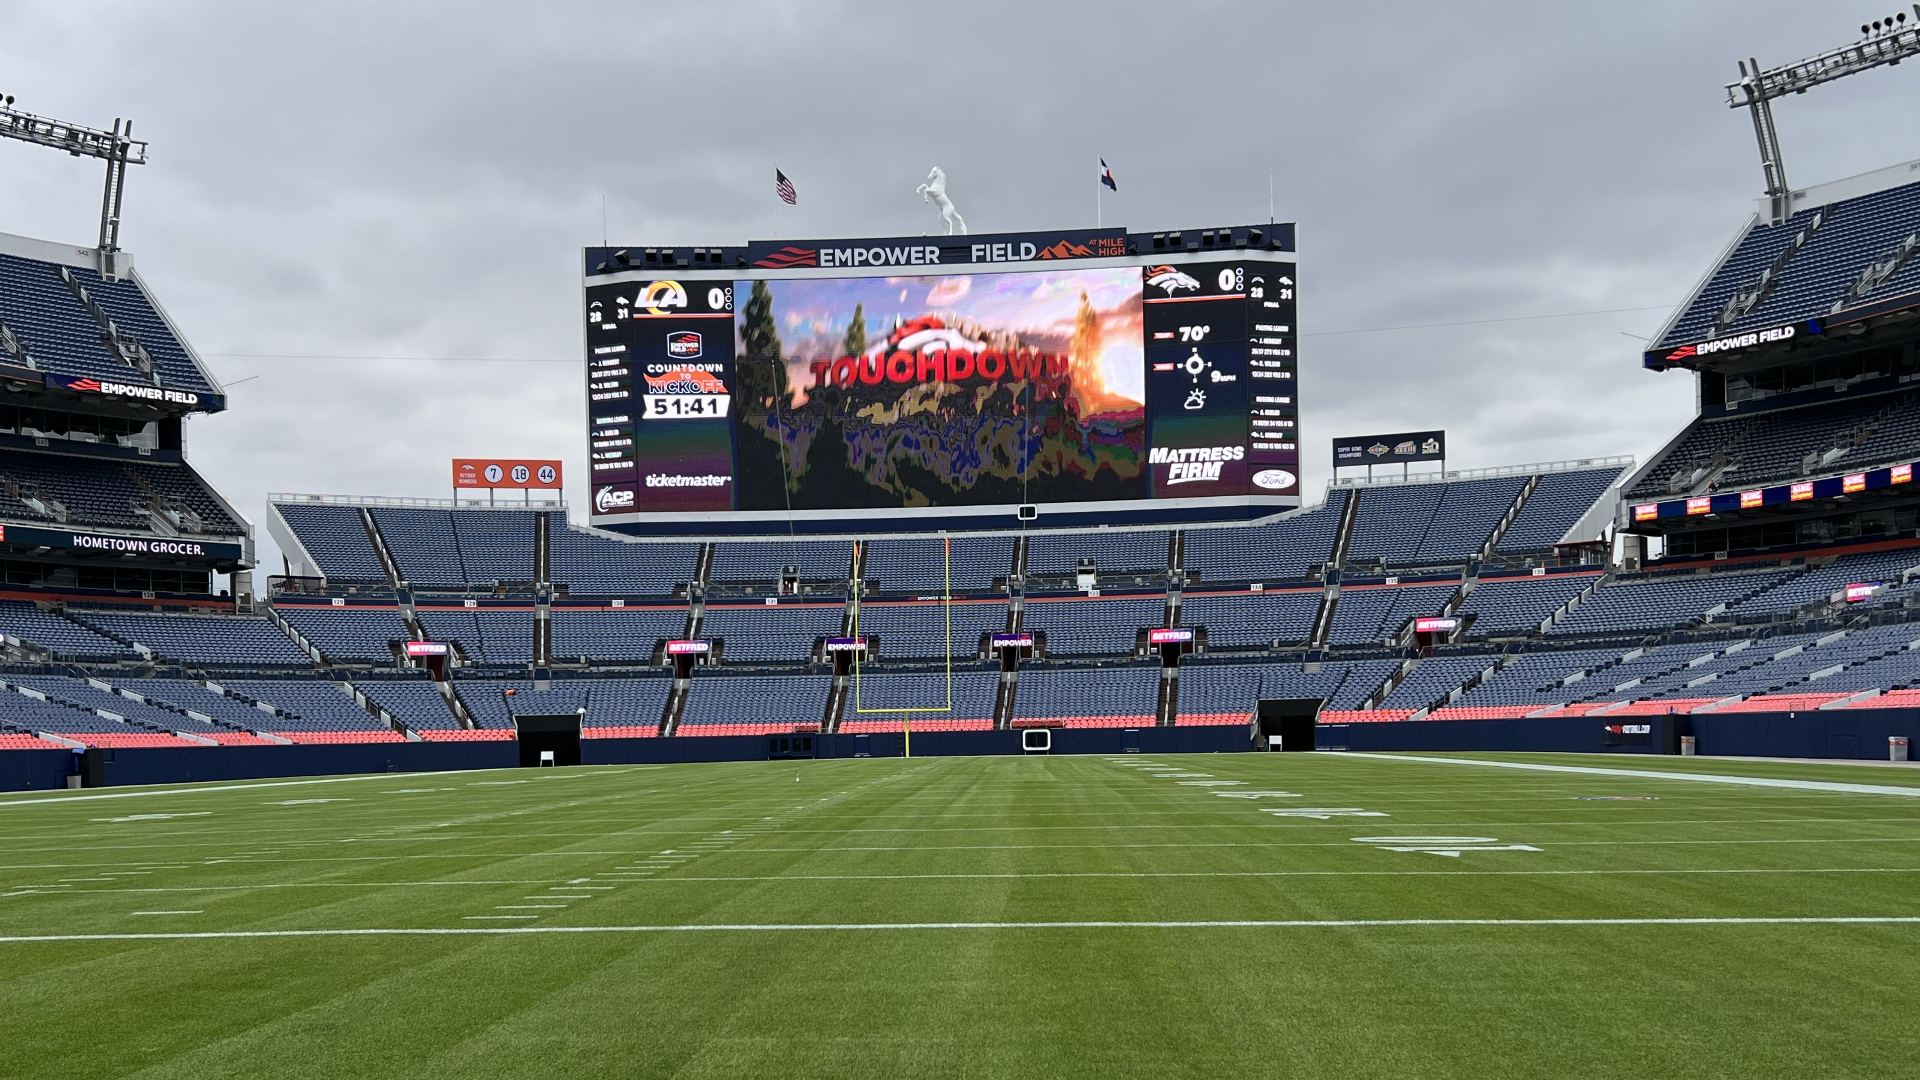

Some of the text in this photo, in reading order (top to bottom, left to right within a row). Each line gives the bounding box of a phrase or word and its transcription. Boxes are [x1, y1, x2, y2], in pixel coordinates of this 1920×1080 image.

[1098, 238, 1124, 247] MILE
[819, 242, 1036, 267] EMPOWER FIELD
[1099, 247, 1126, 256] HIGH
[1218, 269, 1236, 291] 0
[708, 287, 725, 310] 0
[1251, 287, 1264, 299] 28
[1280, 288, 1292, 300] 31
[590, 311, 602, 323] 28
[618, 308, 629, 319] 31
[1696, 326, 1795, 356] EMPOWER FIELD
[647, 363, 724, 373] COUNTDOWN
[810, 347, 1069, 387] TOUCHDOWN
[100, 382, 198, 404] EMPOWER FIELD
[649, 380, 723, 394] KICKOFF
[653, 398, 718, 415] 51:41
[1149, 446, 1244, 463] MATTRESS
[514, 468, 527, 480] 18
[540, 468, 553, 480] 44
[1169, 461, 1224, 479] FIRM
[645, 474, 727, 487] ticketmaster
[1261, 474, 1287, 485] Ford
[601, 491, 634, 503] ACP
[73, 535, 205, 556] HOMETOWN GROCER.
[1417, 619, 1456, 629] BETFRED
[1152, 631, 1192, 640] BETFRED
[408, 644, 447, 653] BETFRED
[669, 643, 709, 652] BETFRED
[827, 643, 866, 651] EMPOWER
[993, 640, 1033, 648] EMPOWER
